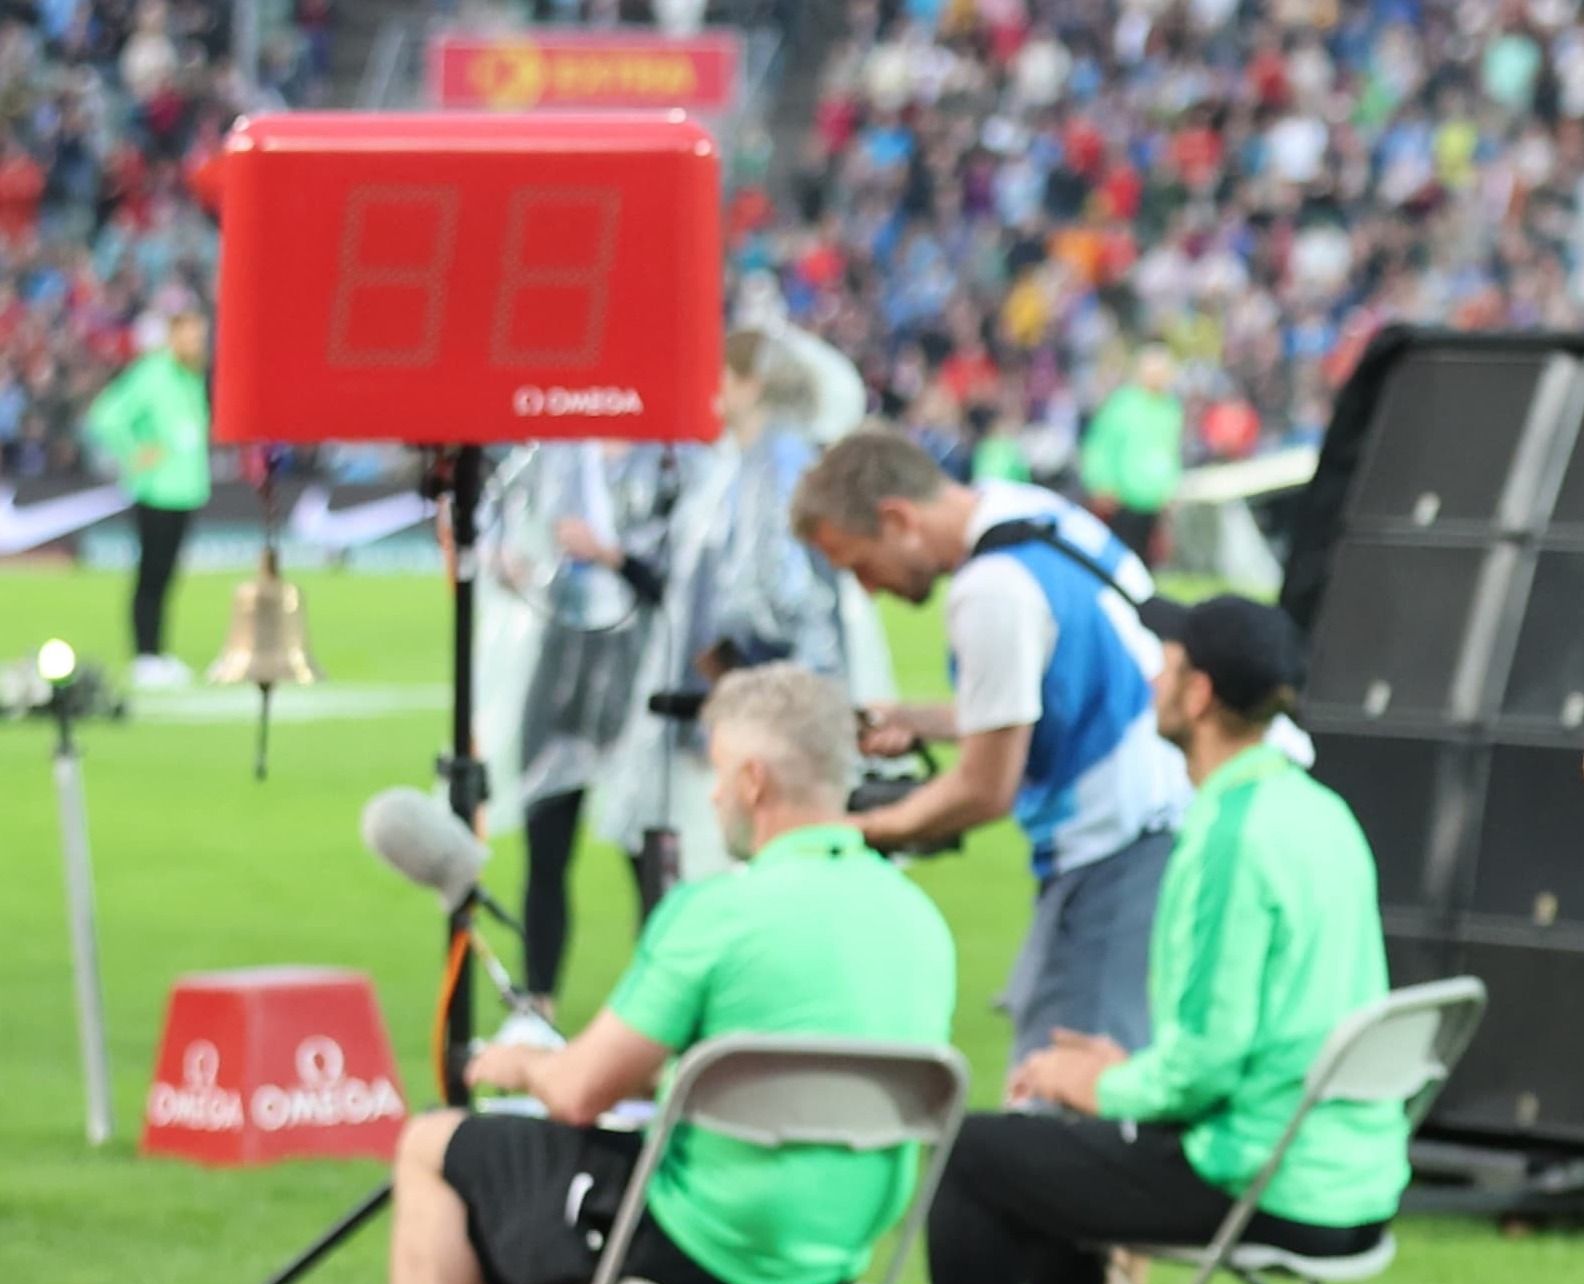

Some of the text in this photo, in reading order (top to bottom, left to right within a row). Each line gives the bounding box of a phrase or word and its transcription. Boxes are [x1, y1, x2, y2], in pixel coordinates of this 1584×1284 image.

[545, 385, 644, 416] OMEGA
[148, 1082, 245, 1131] OMEGA
[251, 1077, 406, 1131] OMEGA
